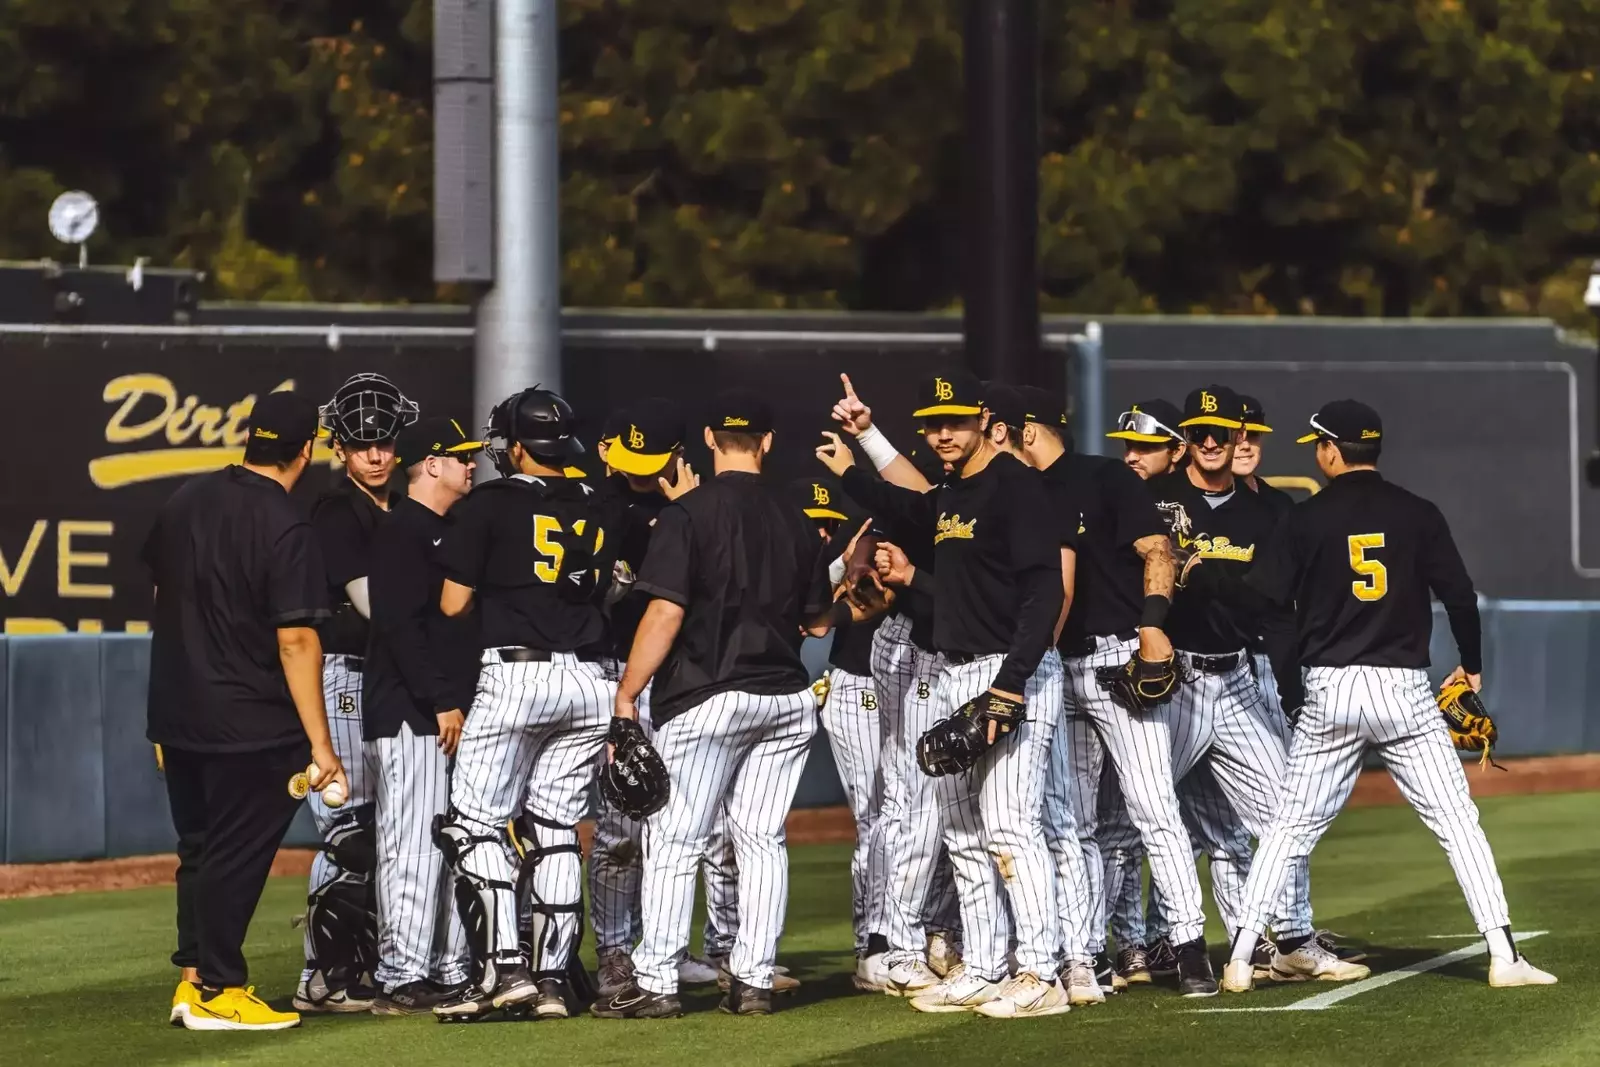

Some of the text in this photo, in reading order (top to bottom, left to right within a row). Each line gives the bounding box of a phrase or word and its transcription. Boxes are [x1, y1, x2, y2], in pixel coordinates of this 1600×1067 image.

[934, 377, 954, 401] LB
[1200, 391, 1218, 413] LB
[628, 424, 645, 449] LB
[811, 483, 830, 506] LB
[1347, 532, 1388, 602] 5
[917, 676, 930, 700] LB
[337, 692, 356, 714] LB
[860, 690, 878, 711] LB
